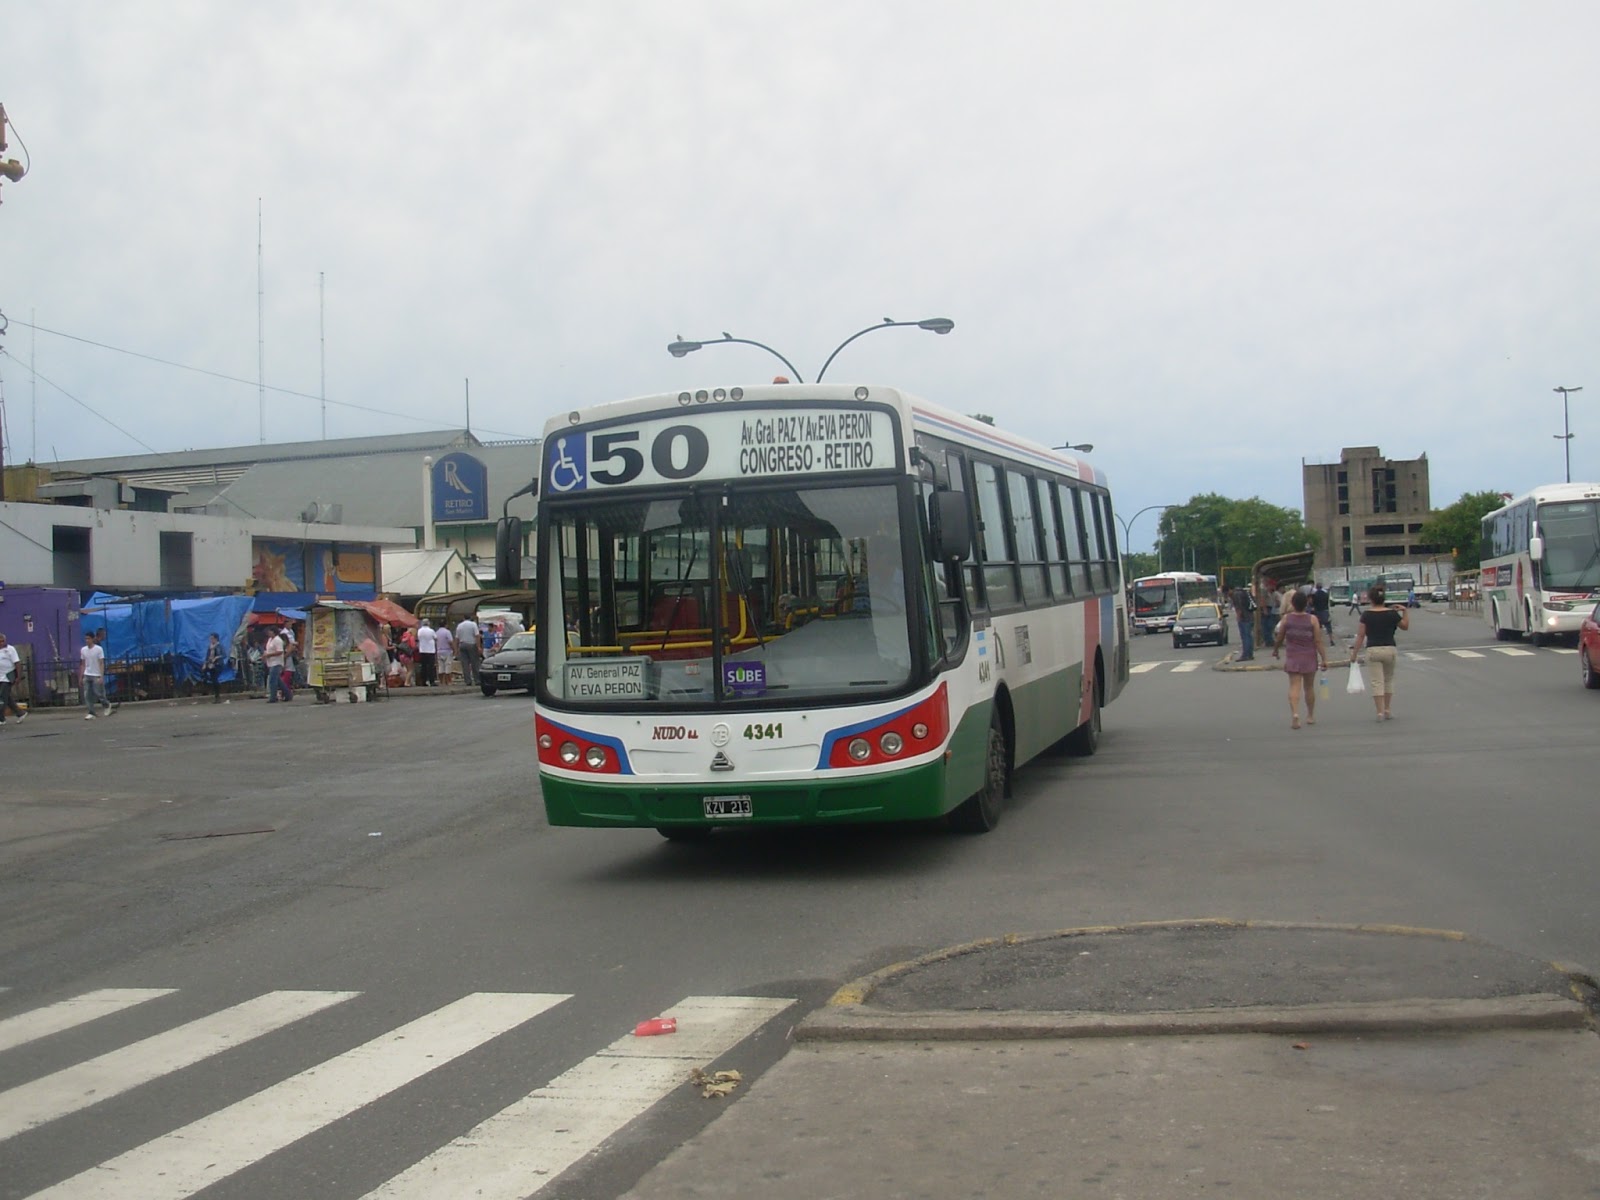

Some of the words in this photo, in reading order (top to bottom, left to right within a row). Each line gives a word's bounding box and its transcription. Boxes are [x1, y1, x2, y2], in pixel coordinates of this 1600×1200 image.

[741, 420, 754, 445] Av.
[778, 416, 796, 443] PAZ
[798, 416, 804, 442] Y
[839, 412, 872, 440] PERON
[590, 425, 709, 485] 50
[740, 444, 813, 474] CONGRESO
[825, 441, 873, 469] RETIRO
[445, 499, 473, 508] RETIRO
[571, 668, 585, 678] AV.
[587, 666, 619, 678] General
[622, 665, 639, 676] PAZ
[727, 668, 762, 682] SUBE
[571, 684, 578, 695] Y
[581, 684, 602, 695] EVA
[605, 682, 642, 694] PERON
[652, 726, 685, 740] NUDO
[743, 723, 783, 740] 4341
[706, 801, 724, 814] KZV
[731, 800, 750, 813] 213
